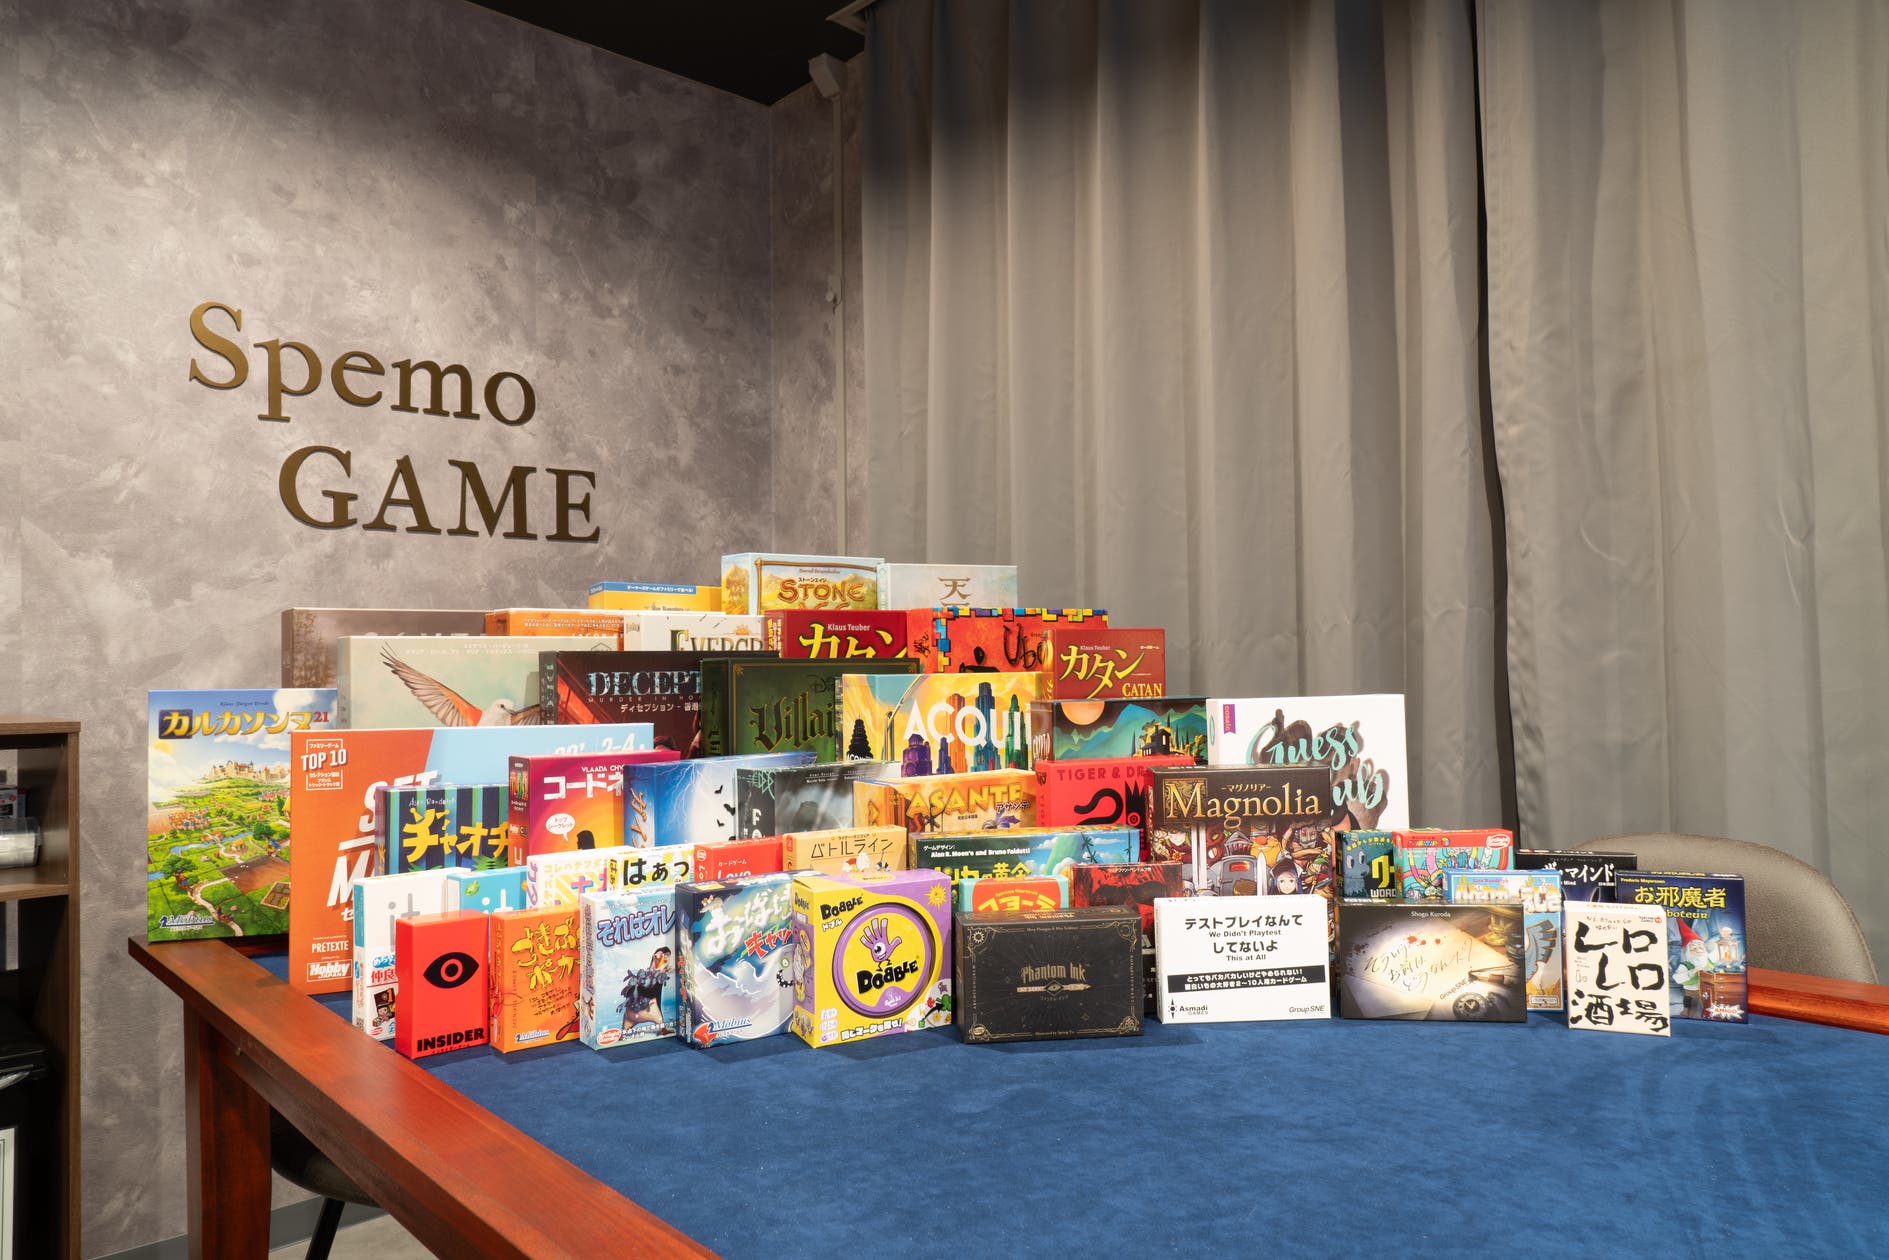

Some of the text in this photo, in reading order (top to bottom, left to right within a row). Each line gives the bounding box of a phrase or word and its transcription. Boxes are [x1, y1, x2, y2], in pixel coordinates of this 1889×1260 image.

[189, 301, 536, 427] Spemo
[278, 445, 600, 543] GAME
[777, 578, 866, 603] STONE
[937, 577, 972, 600] 天
[827, 623, 871, 632] Klaus Teuber
[587, 671, 701, 696] DECEPT
[1059, 645, 1145, 700] カタン
[1121, 682, 1163, 697] CATAN
[313, 711, 331, 724] 21
[749, 691, 835, 752] Villai
[903, 700, 1031, 751] ACQUI
[300, 749, 347, 771] TOP 10
[1057, 768, 1107, 781] TIGER
[1111, 769, 1121, 779] &
[543, 772, 624, 800] コードネ
[905, 783, 1024, 818] ASANTE
[995, 801, 1031, 812] アサンテ
[1165, 782, 1322, 830] Magnolia
[402, 808, 508, 863] チャオチ
[811, 837, 894, 859] バトルライン
[1634, 885, 1727, 909] お邪魔者
[1184, 914, 1304, 931] テストプレイなんて
[1411, 910, 1429, 918] Shogo
[1666, 909, 1709, 919] boteur
[745, 929, 793, 959] キャッ
[1223, 929, 1247, 938] Didn't
[1249, 929, 1282, 939] Playtest
[1213, 940, 1278, 954] してないよ
[1255, 953, 1267, 961] All
[310, 961, 350, 977] Hobby
[1020, 962, 1087, 984] Phantom Ink
[1179, 1004, 1209, 1013] Asmadi
[1569, 988, 1669, 1033] 酒場
[416, 1027, 485, 1053] INSIDER
